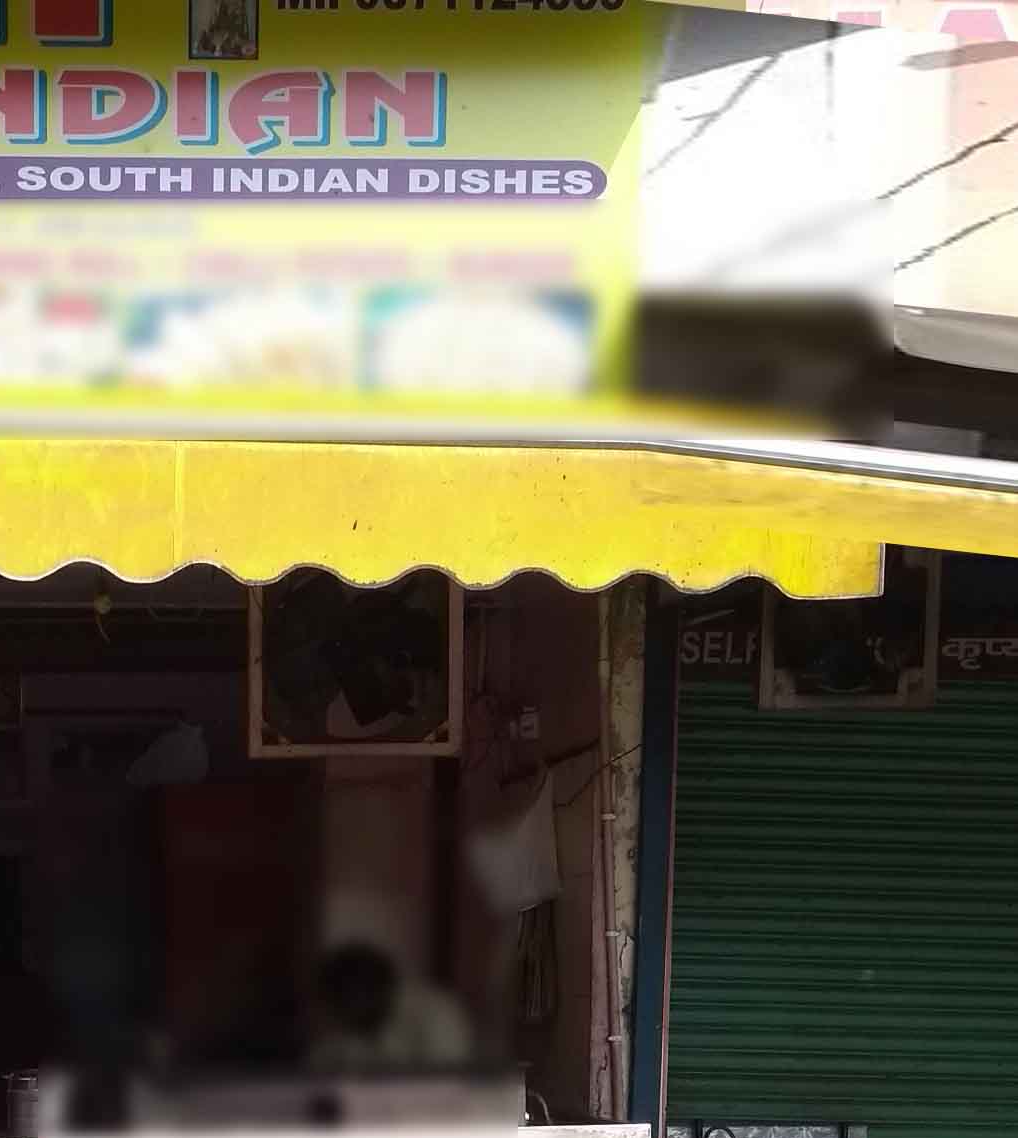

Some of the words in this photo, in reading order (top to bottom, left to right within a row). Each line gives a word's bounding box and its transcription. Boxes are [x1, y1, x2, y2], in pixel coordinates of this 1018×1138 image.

[16, 165, 192, 193] SOUTH
[213, 167, 389, 194] INDIAN
[408, 168, 594, 195] DISHES
